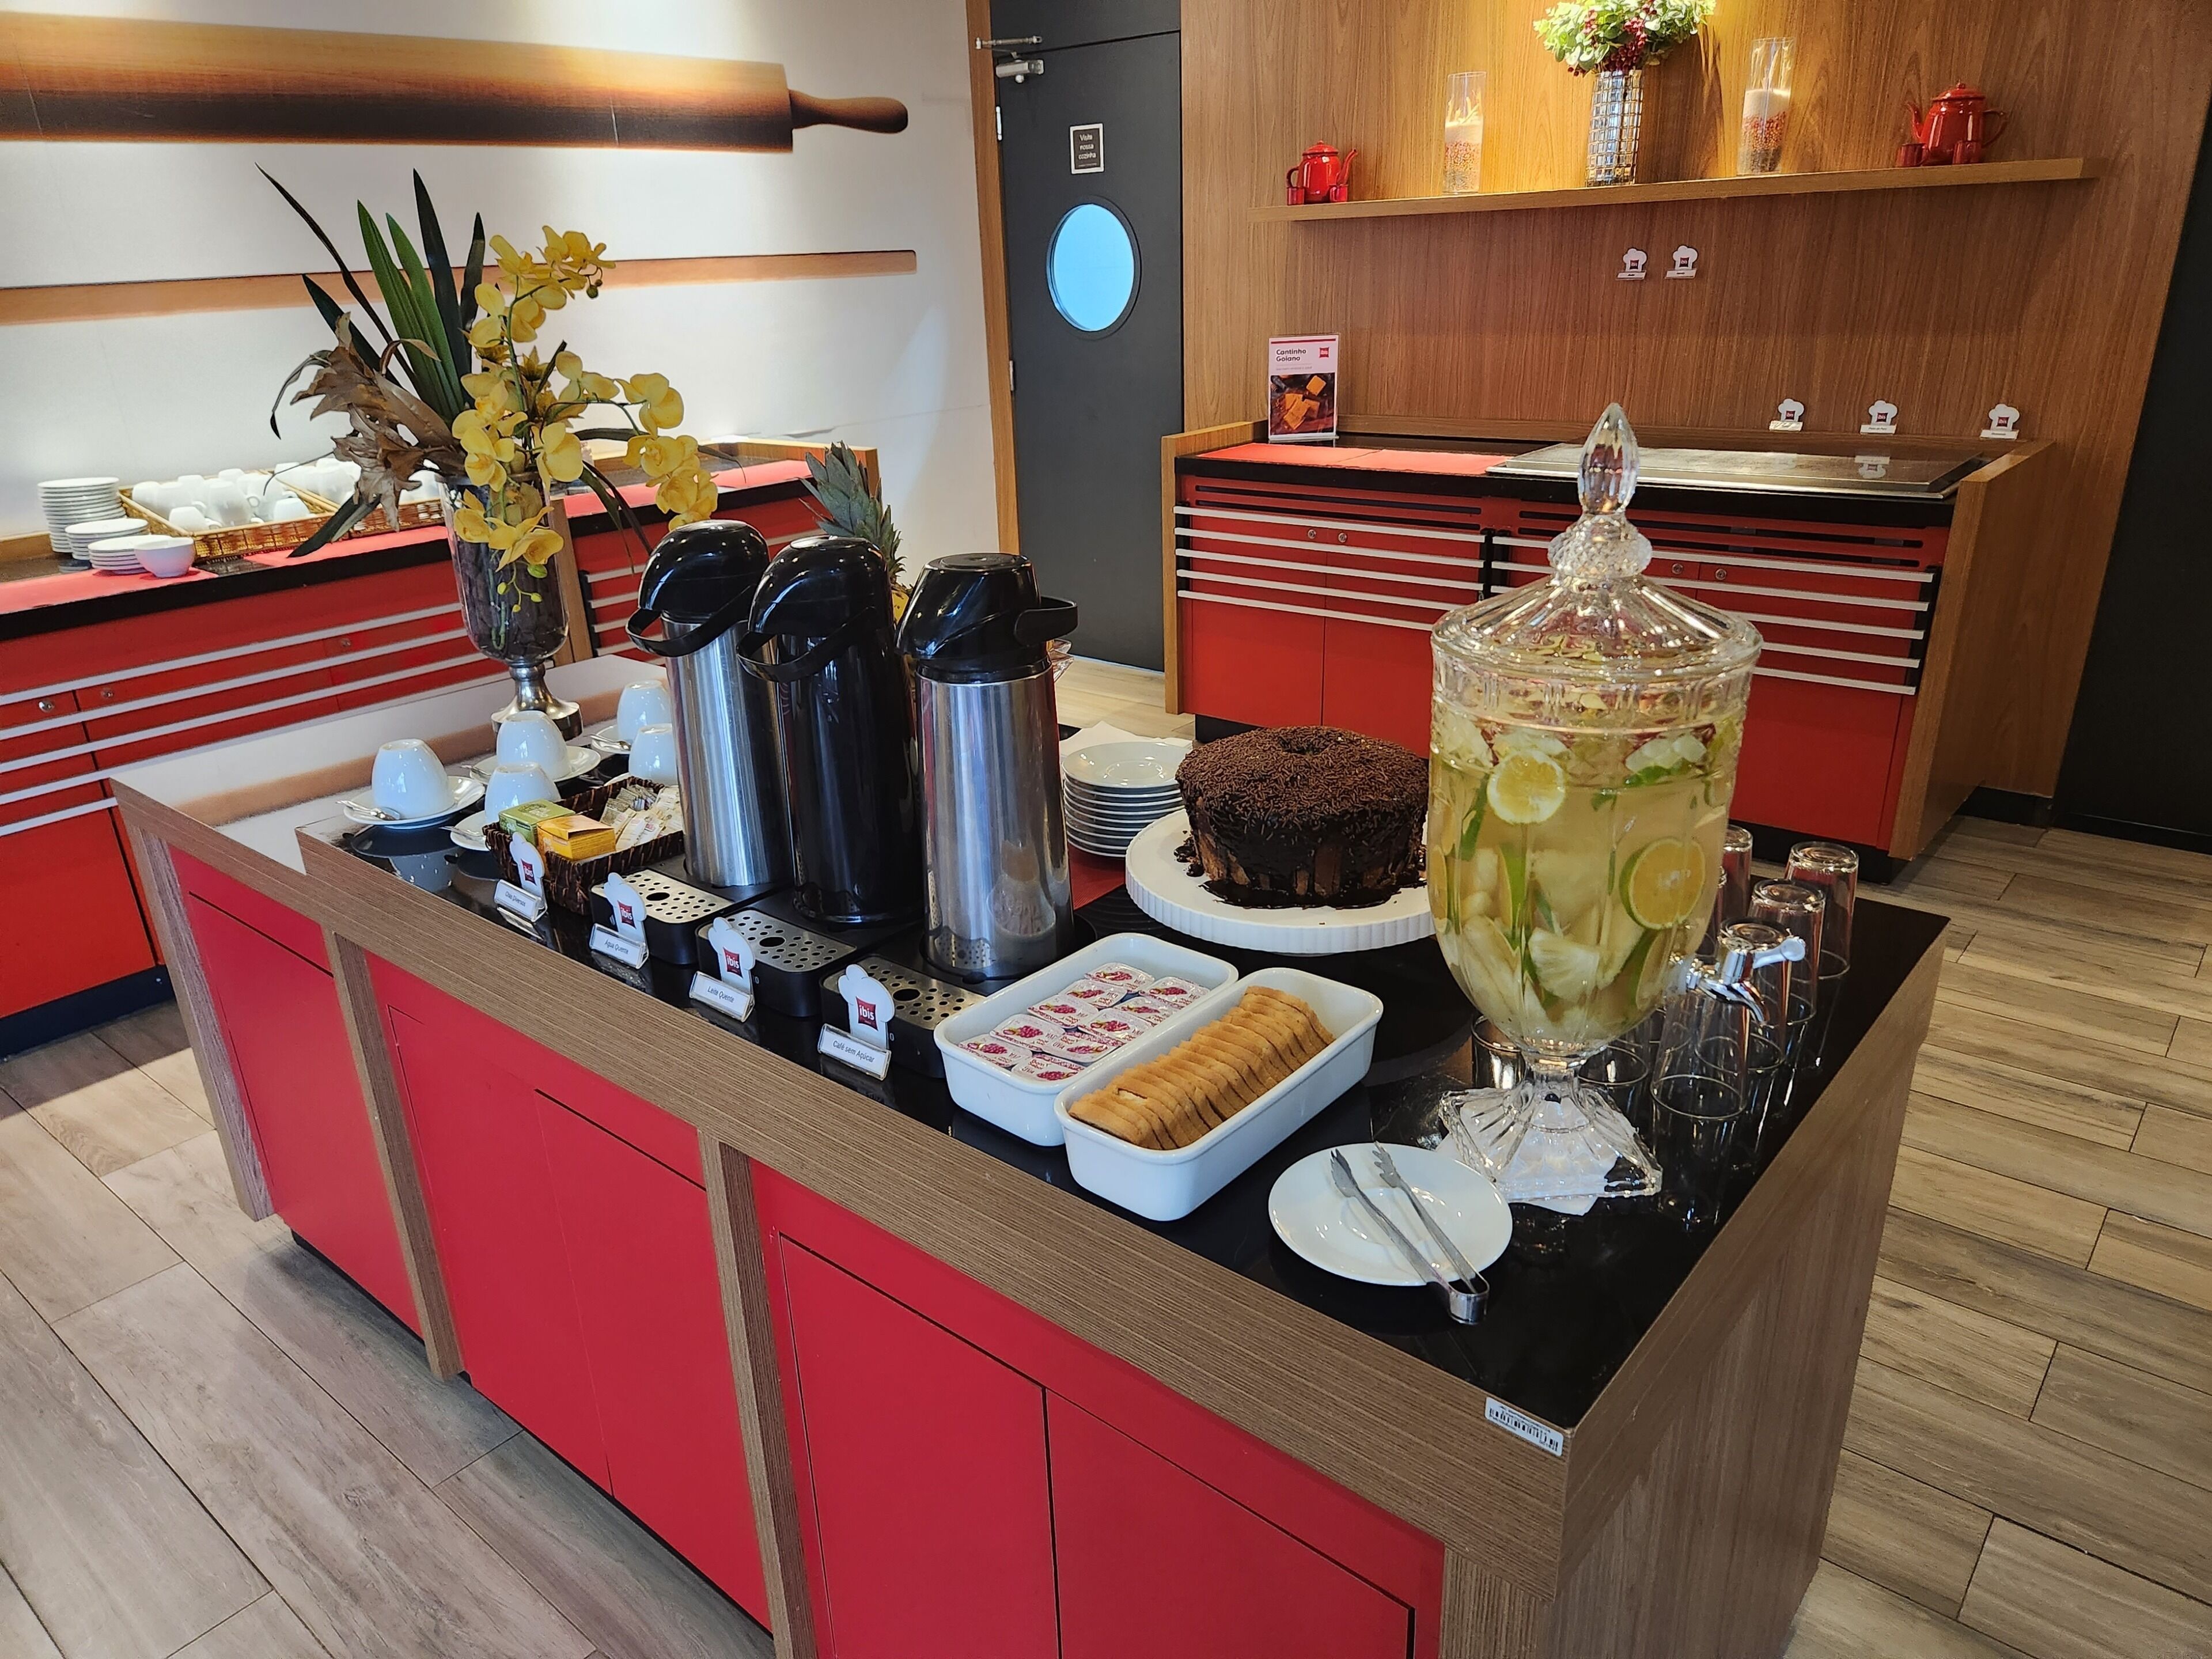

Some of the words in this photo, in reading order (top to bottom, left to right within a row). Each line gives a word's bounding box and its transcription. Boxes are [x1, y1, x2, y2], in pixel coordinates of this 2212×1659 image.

[523, 865, 533, 877] ibis
[620, 907, 632, 920] ibis
[615, 944, 629, 955] Quente
[726, 955, 740, 968] ibis
[707, 986, 719, 995] Leite
[718, 991, 734, 1003] Quente
[859, 1005, 875, 1021] ibis
[833, 1040, 844, 1051] Café
[844, 1047, 856, 1055] sem
[856, 1050, 875, 1063] Açúcar
